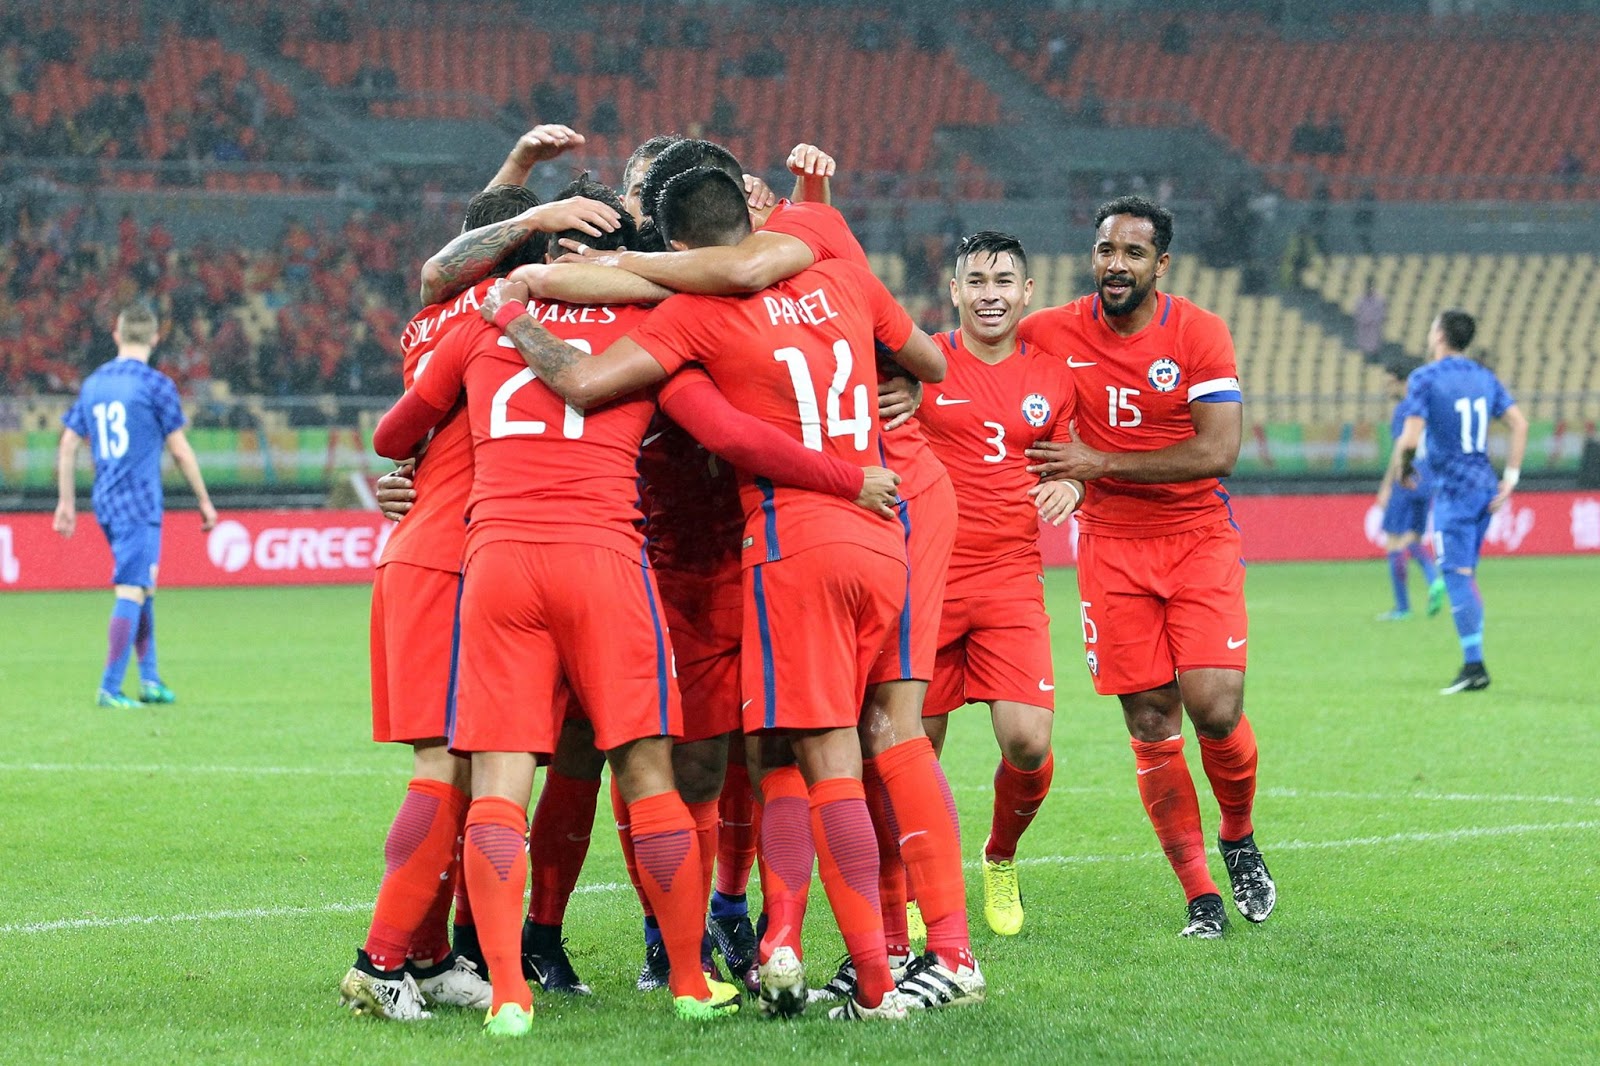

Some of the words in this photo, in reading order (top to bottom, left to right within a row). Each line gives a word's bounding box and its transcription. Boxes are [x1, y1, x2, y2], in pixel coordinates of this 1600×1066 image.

[526, 300, 616, 324] NARES
[773, 339, 872, 452] 14
[1106, 386, 1142, 428] 15
[93, 401, 130, 460] 13
[983, 421, 1007, 463] 3
[1454, 396, 1488, 454] 11
[253, 527, 375, 571] GREE
